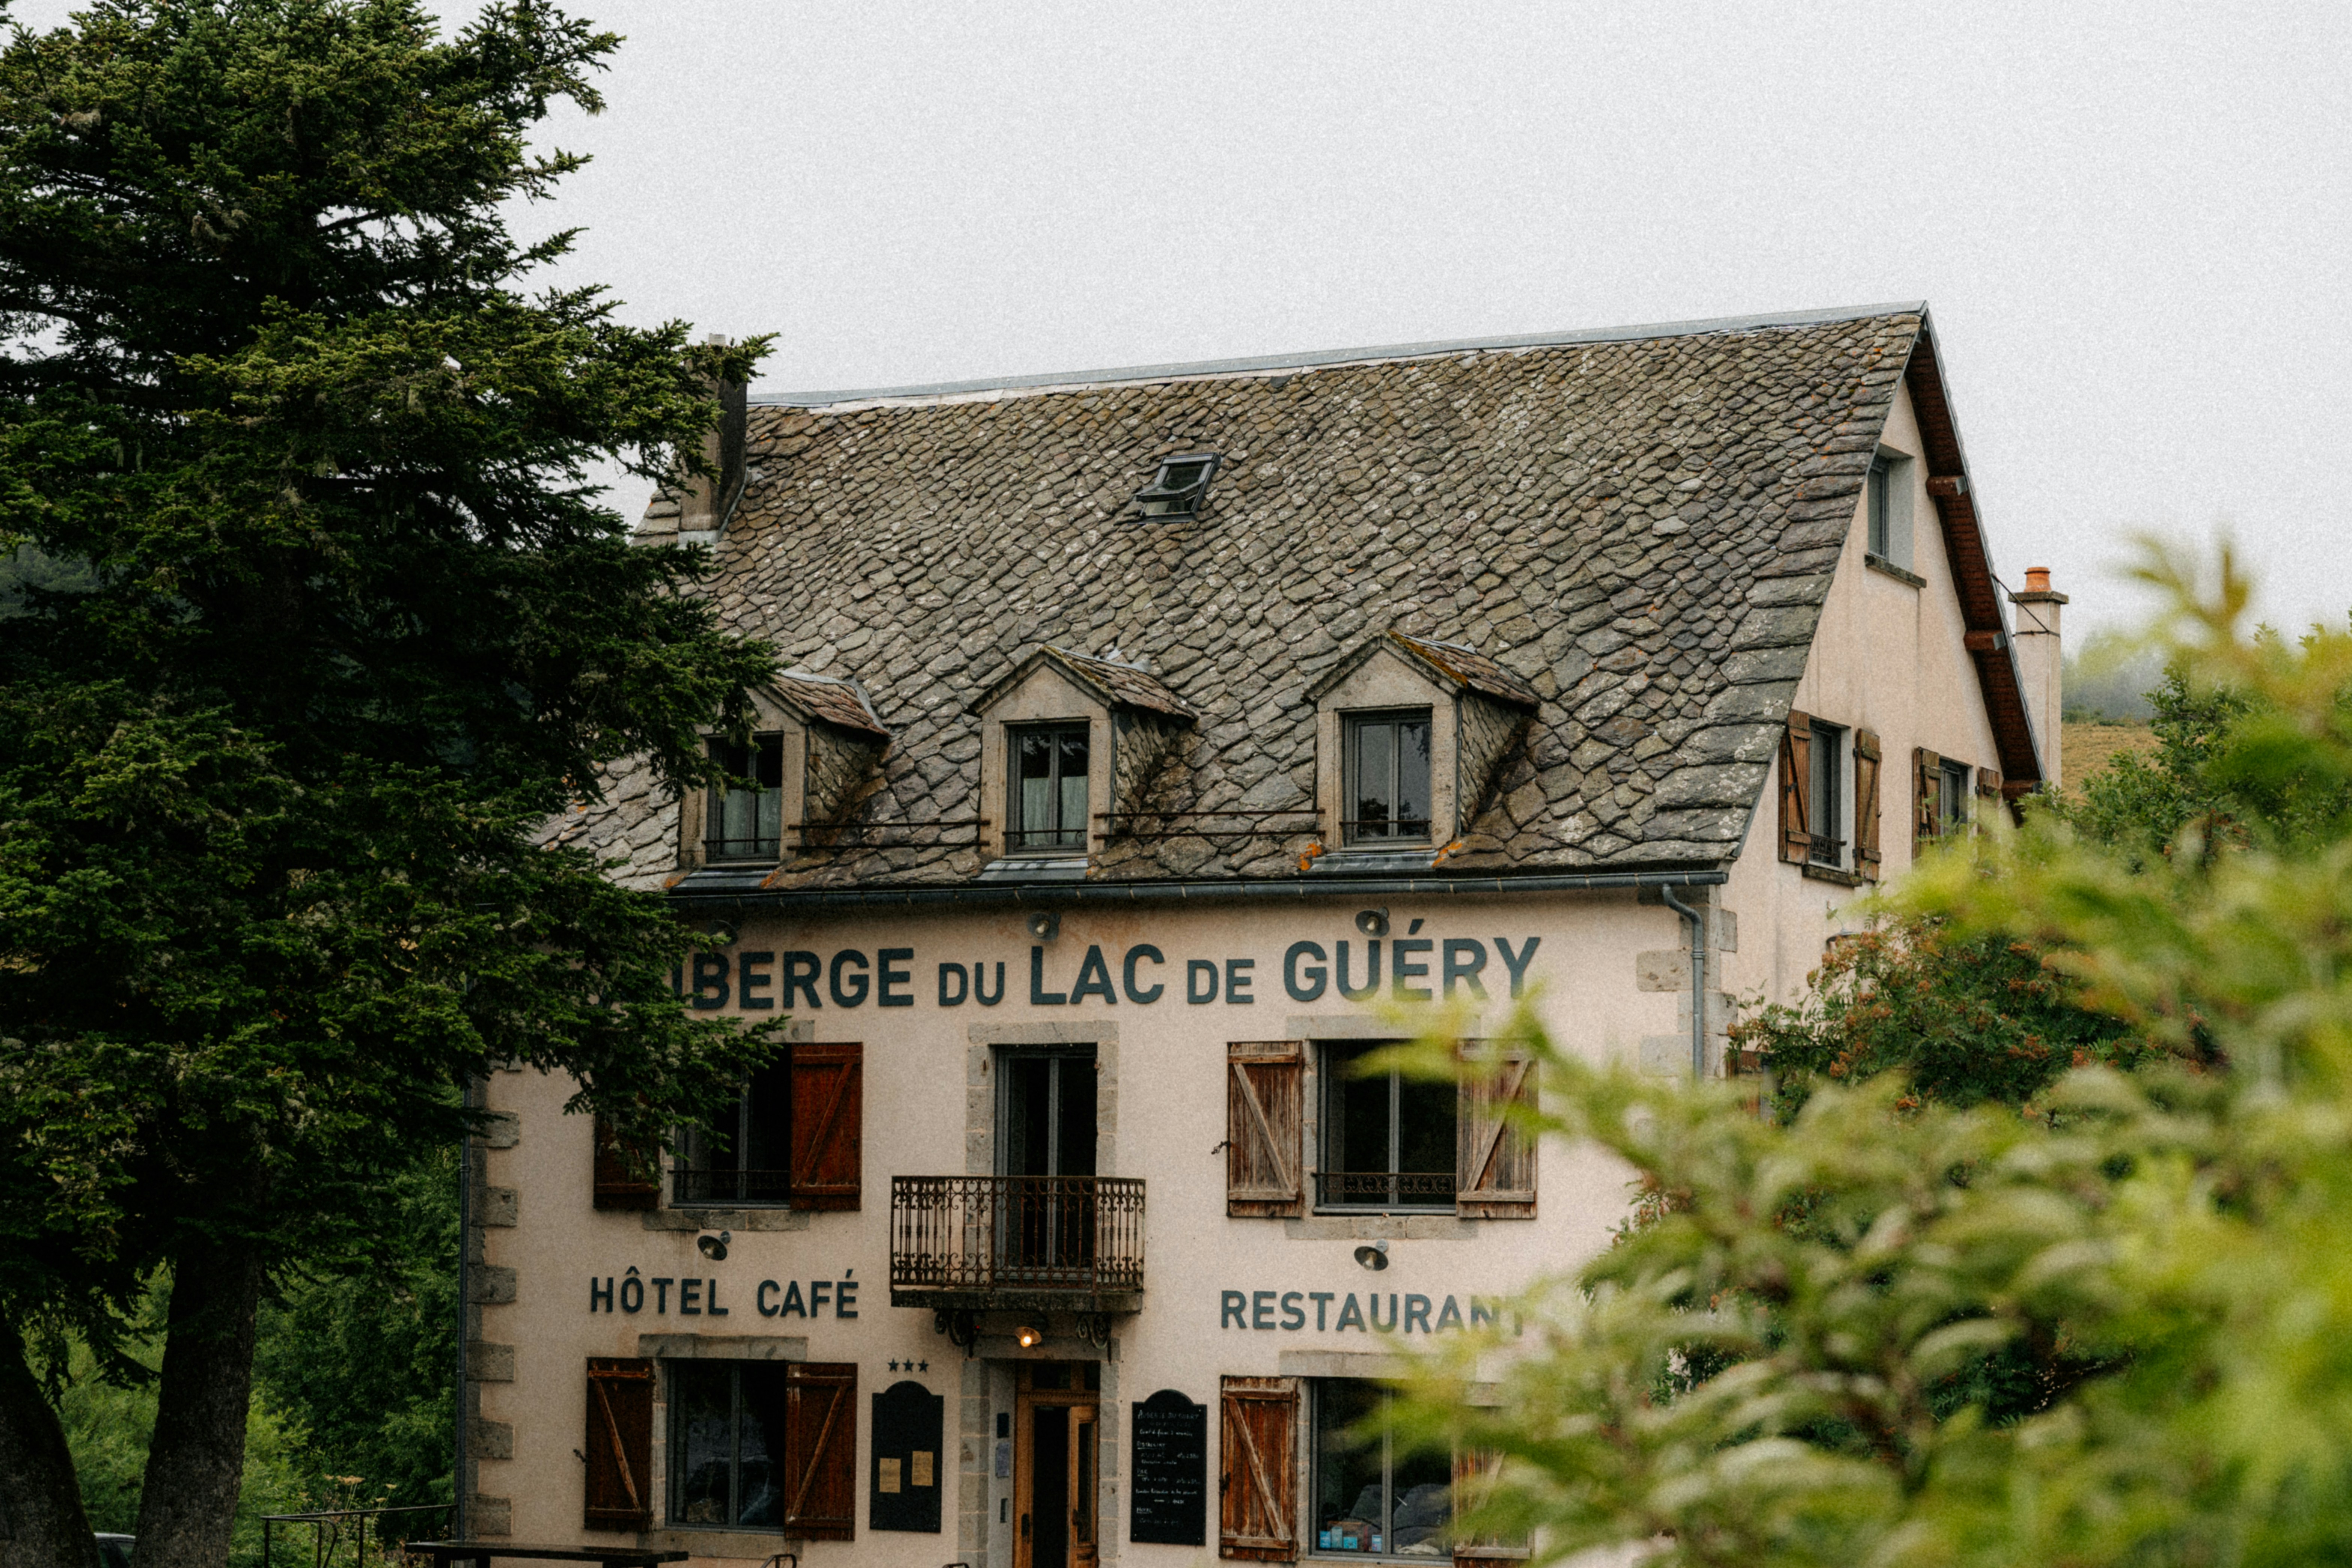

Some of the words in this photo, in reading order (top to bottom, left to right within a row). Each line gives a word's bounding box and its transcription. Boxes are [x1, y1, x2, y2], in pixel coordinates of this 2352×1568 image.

[599, 947, 914, 1009] BERGE
[939, 961, 1005, 1006] DU
[1030, 943, 1165, 1005] LAC
[1186, 958, 1255, 1005] DE
[1283, 918, 1541, 1003] GUÉRY
[591, 1265, 729, 1316] HÔTEL
[757, 1268, 859, 1318] CAFÉ
